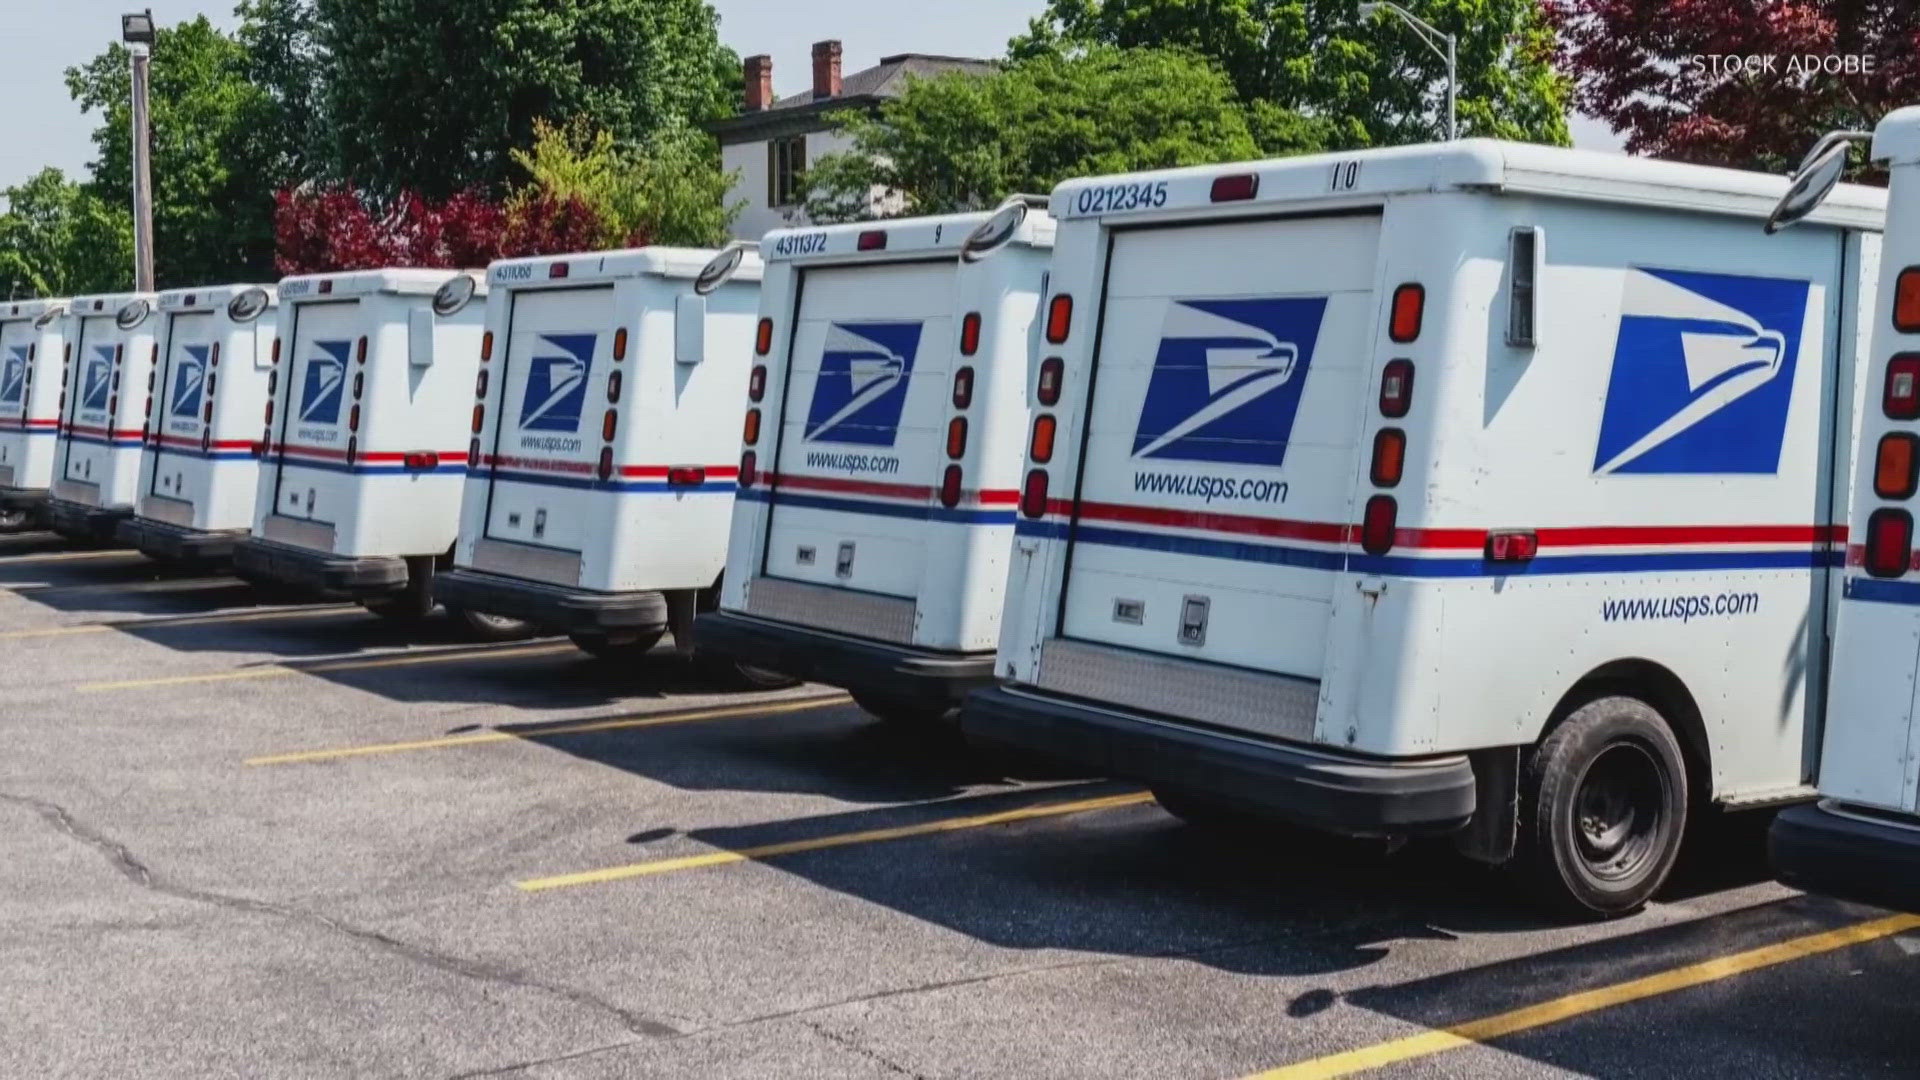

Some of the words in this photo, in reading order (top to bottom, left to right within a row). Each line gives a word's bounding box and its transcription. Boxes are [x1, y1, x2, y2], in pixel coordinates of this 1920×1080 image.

[1078, 181, 1168, 214] 0212345
[775, 233, 828, 255] 4311372
[935, 224, 942, 244] 9
[520, 436, 582, 453] www.usps.com
[806, 451, 900, 475] www.usps.com
[1134, 471, 1289, 503] www.usps.com
[1602, 591, 1760, 624] www.usps.com
